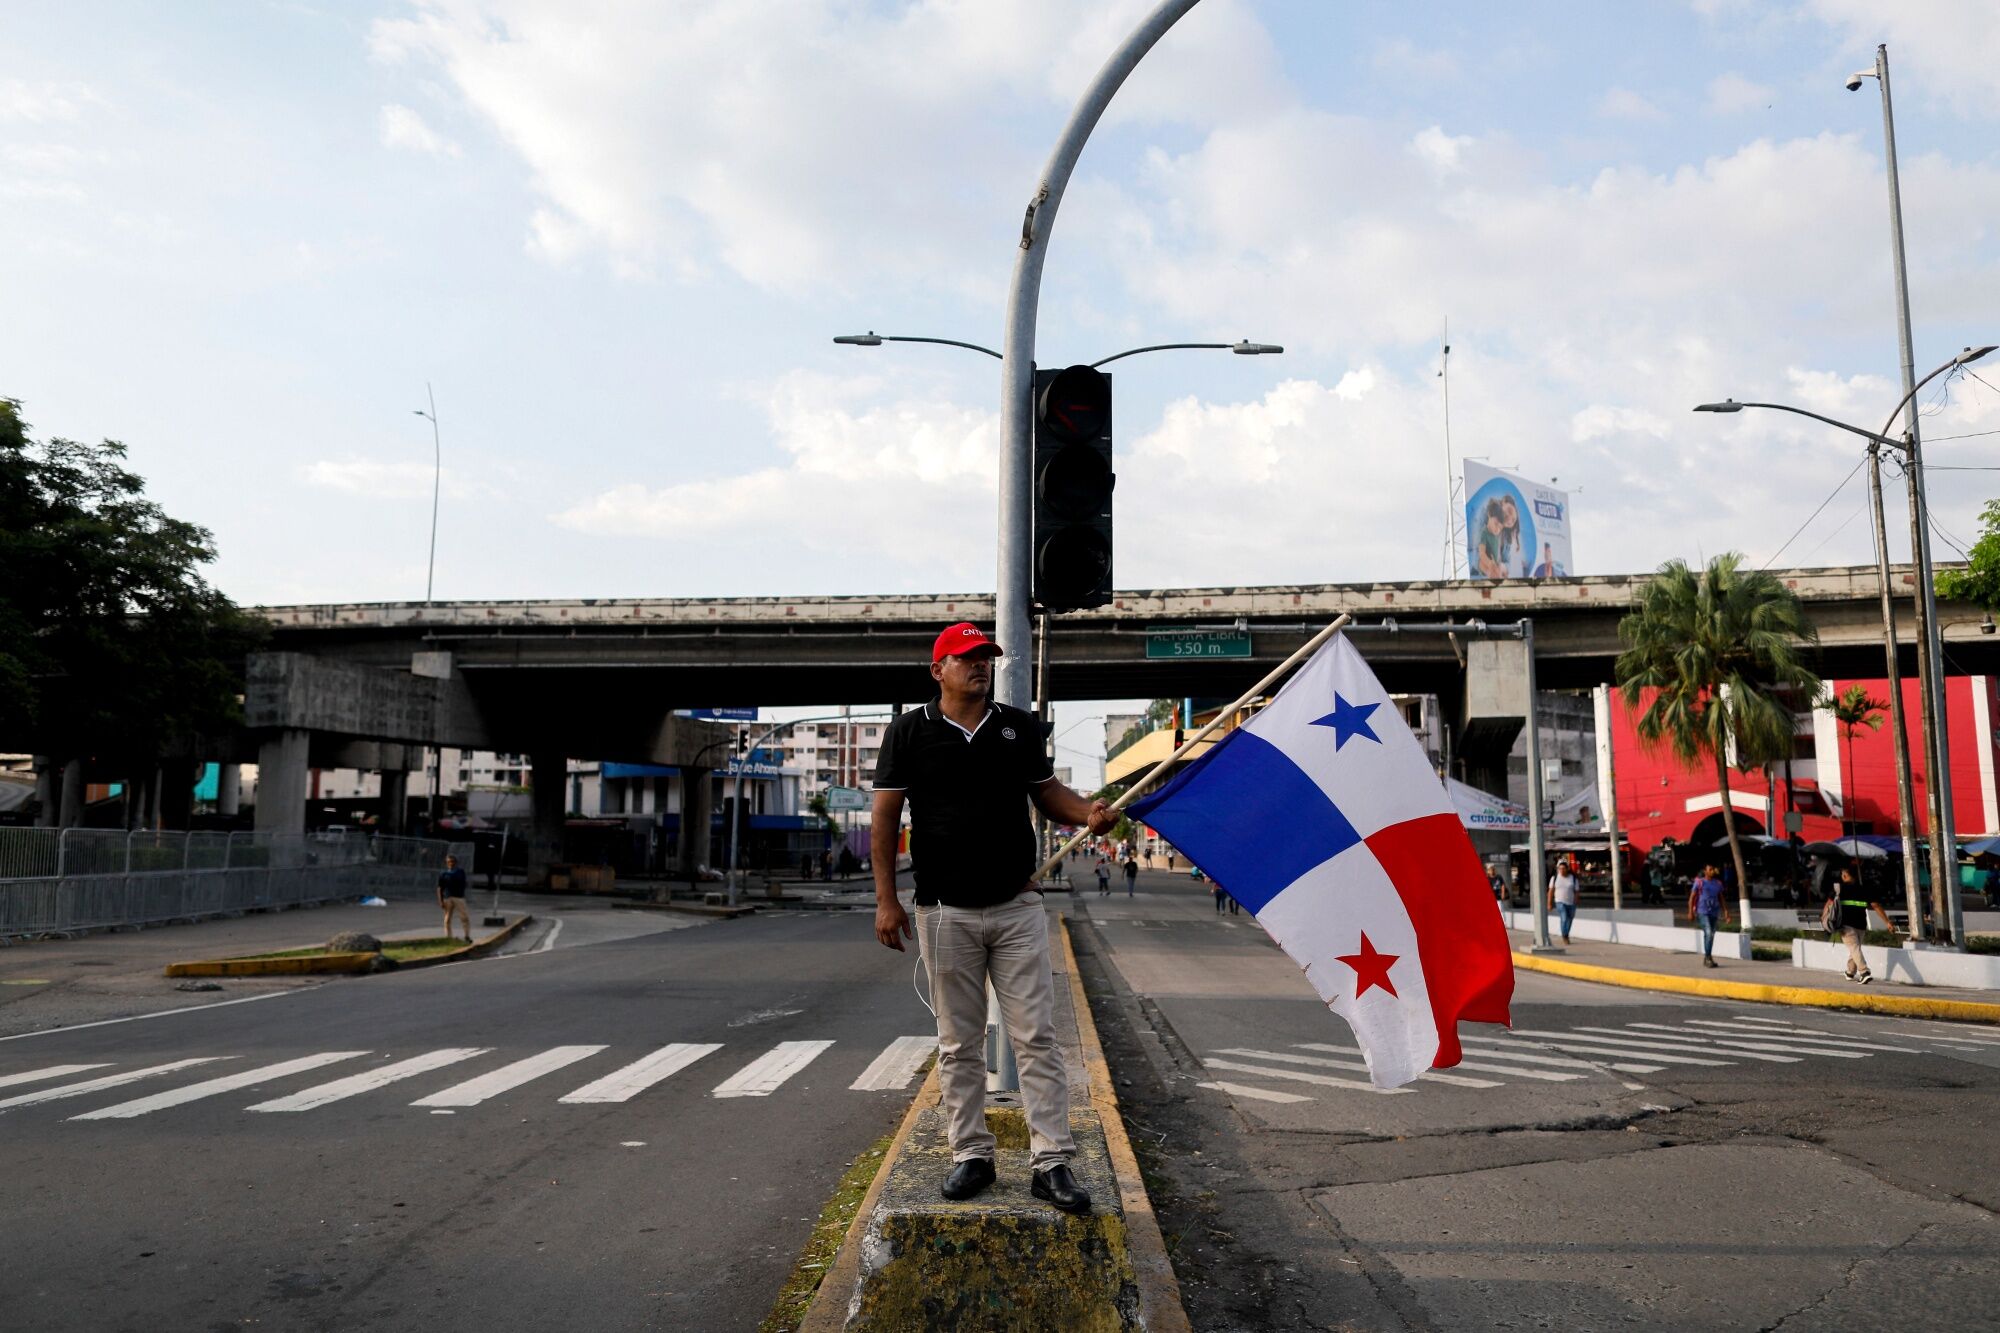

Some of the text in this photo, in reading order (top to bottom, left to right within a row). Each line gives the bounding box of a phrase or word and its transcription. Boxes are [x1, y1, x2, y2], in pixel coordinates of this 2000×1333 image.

[1153, 629, 1245, 641] ALTURA LIBRE
[1174, 642, 1225, 655] 5.50 m.
[1470, 815, 1510, 823] CIUDAD
